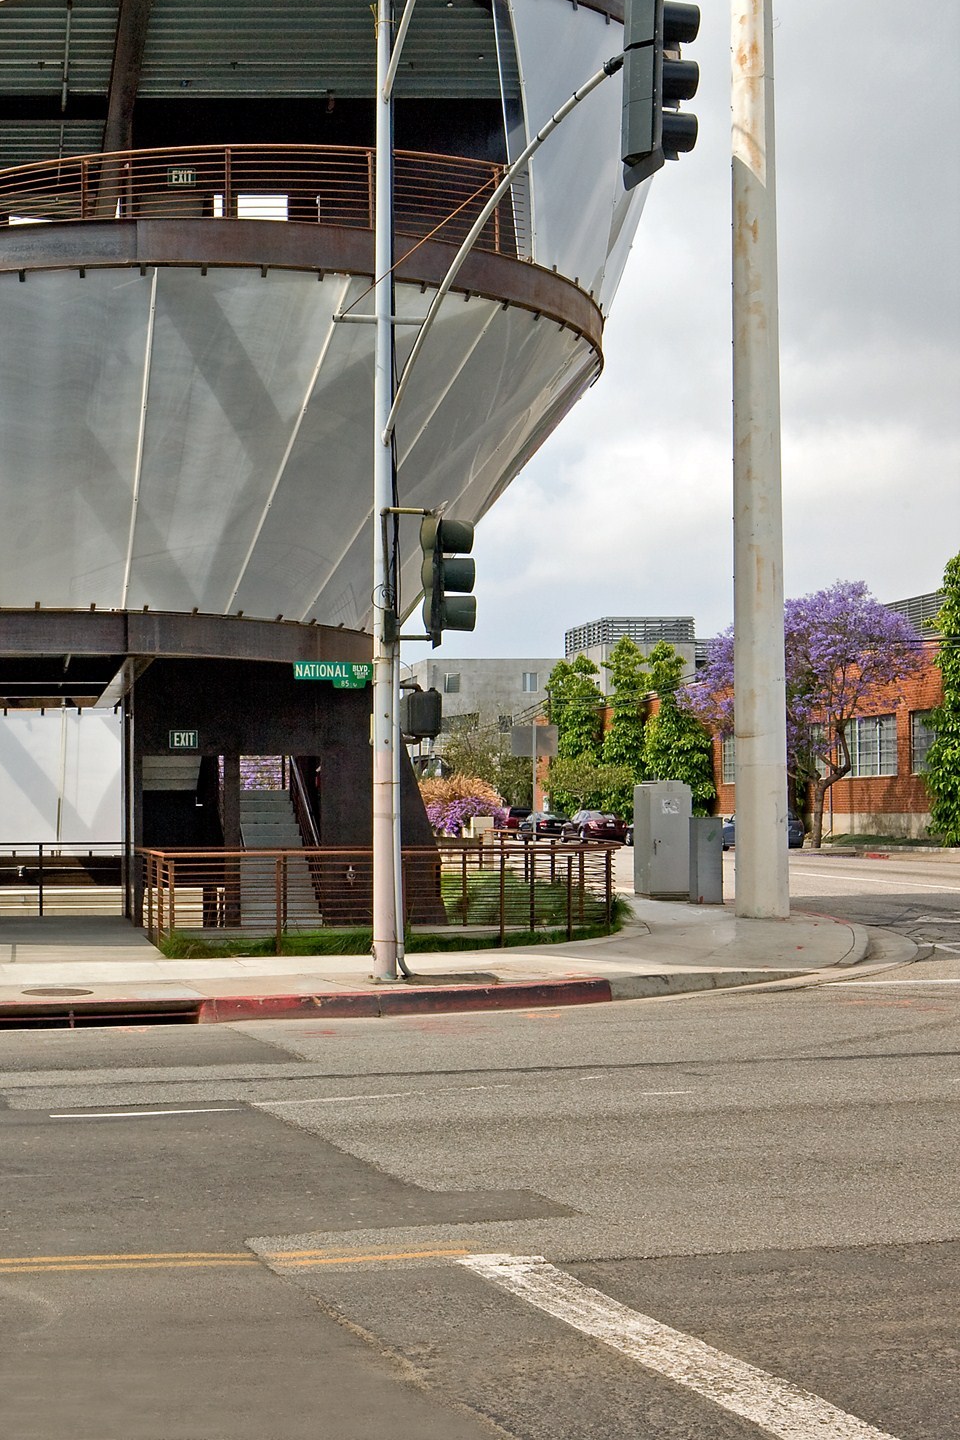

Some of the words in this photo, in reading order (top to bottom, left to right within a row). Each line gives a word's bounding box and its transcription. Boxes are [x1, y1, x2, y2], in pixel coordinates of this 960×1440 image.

[172, 170, 193, 184] EXIT
[295, 664, 349, 678] NATIONAL
[174, 732, 195, 747] EXIT
